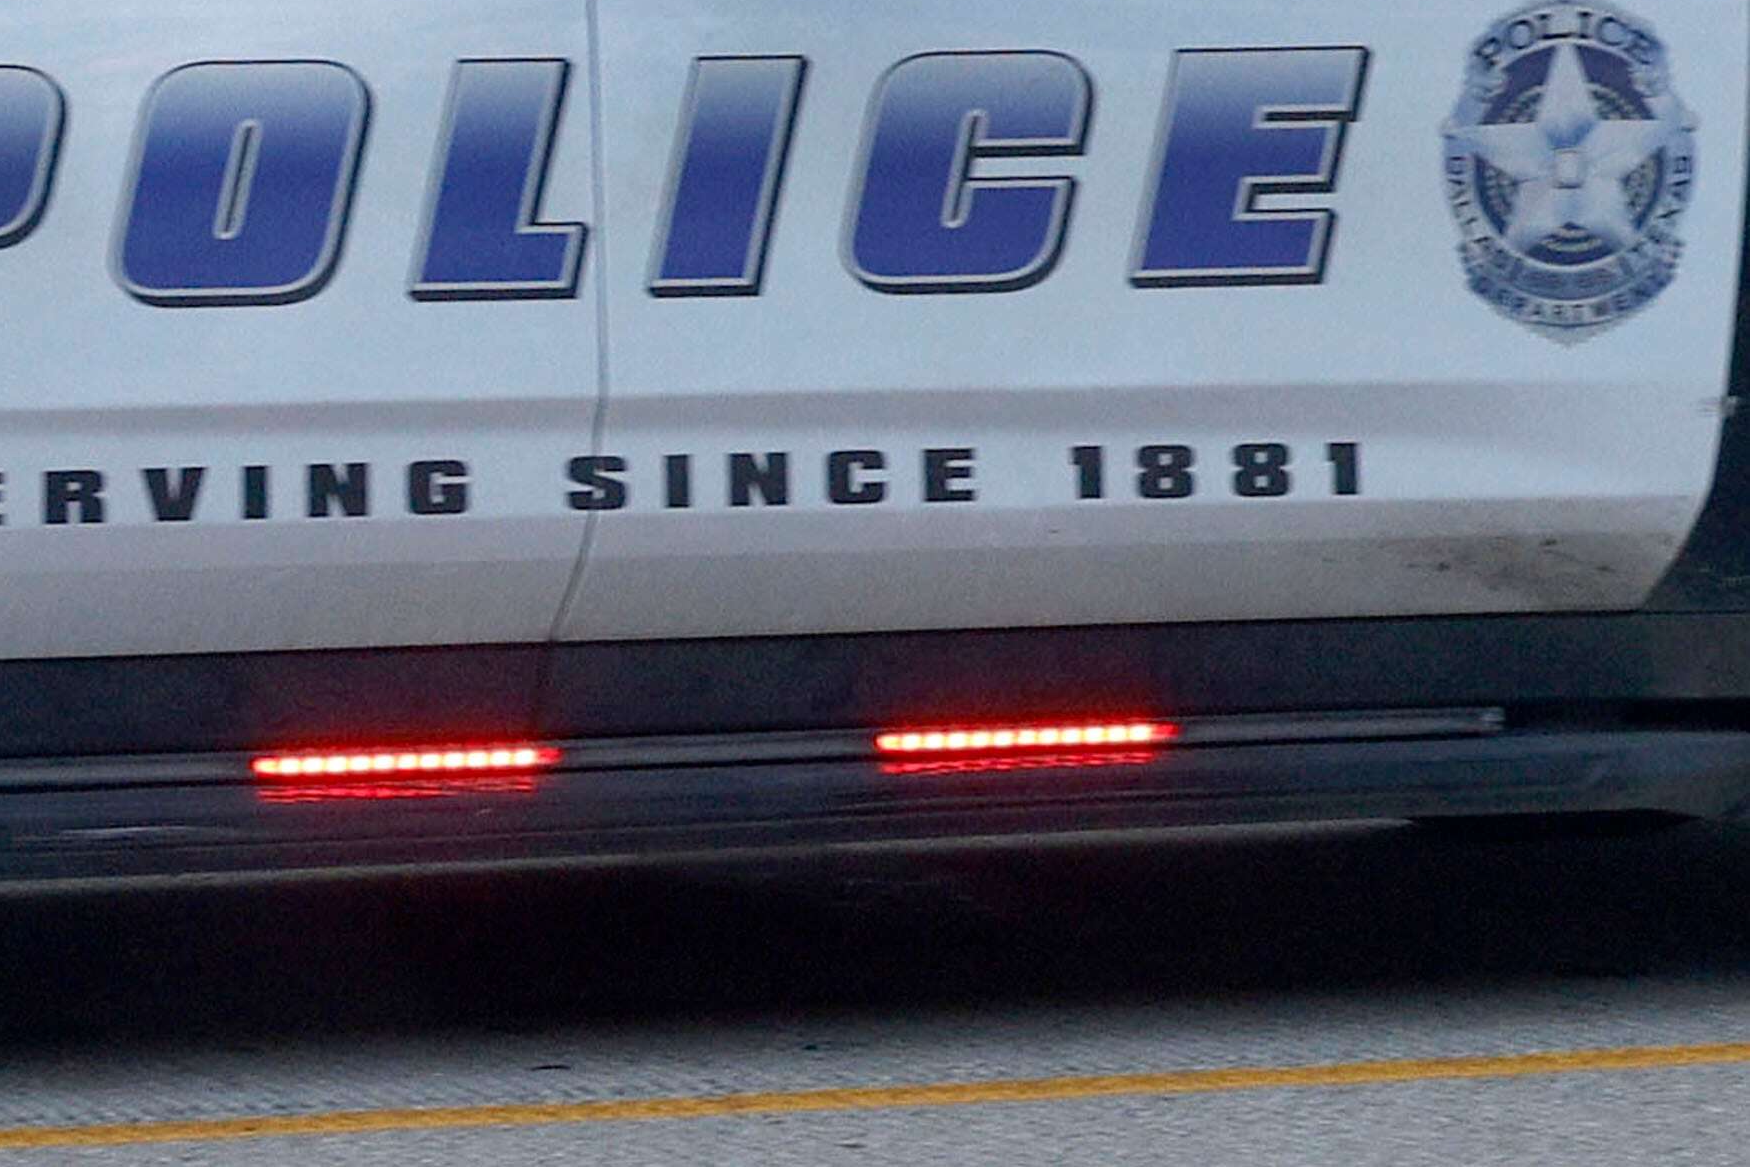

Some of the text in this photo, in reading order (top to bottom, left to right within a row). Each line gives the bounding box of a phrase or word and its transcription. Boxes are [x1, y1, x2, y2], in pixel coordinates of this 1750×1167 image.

[1474, 9, 1666, 70] POLICE
[566, 447, 978, 513] SINCE
[1069, 441, 1362, 500] 1881
